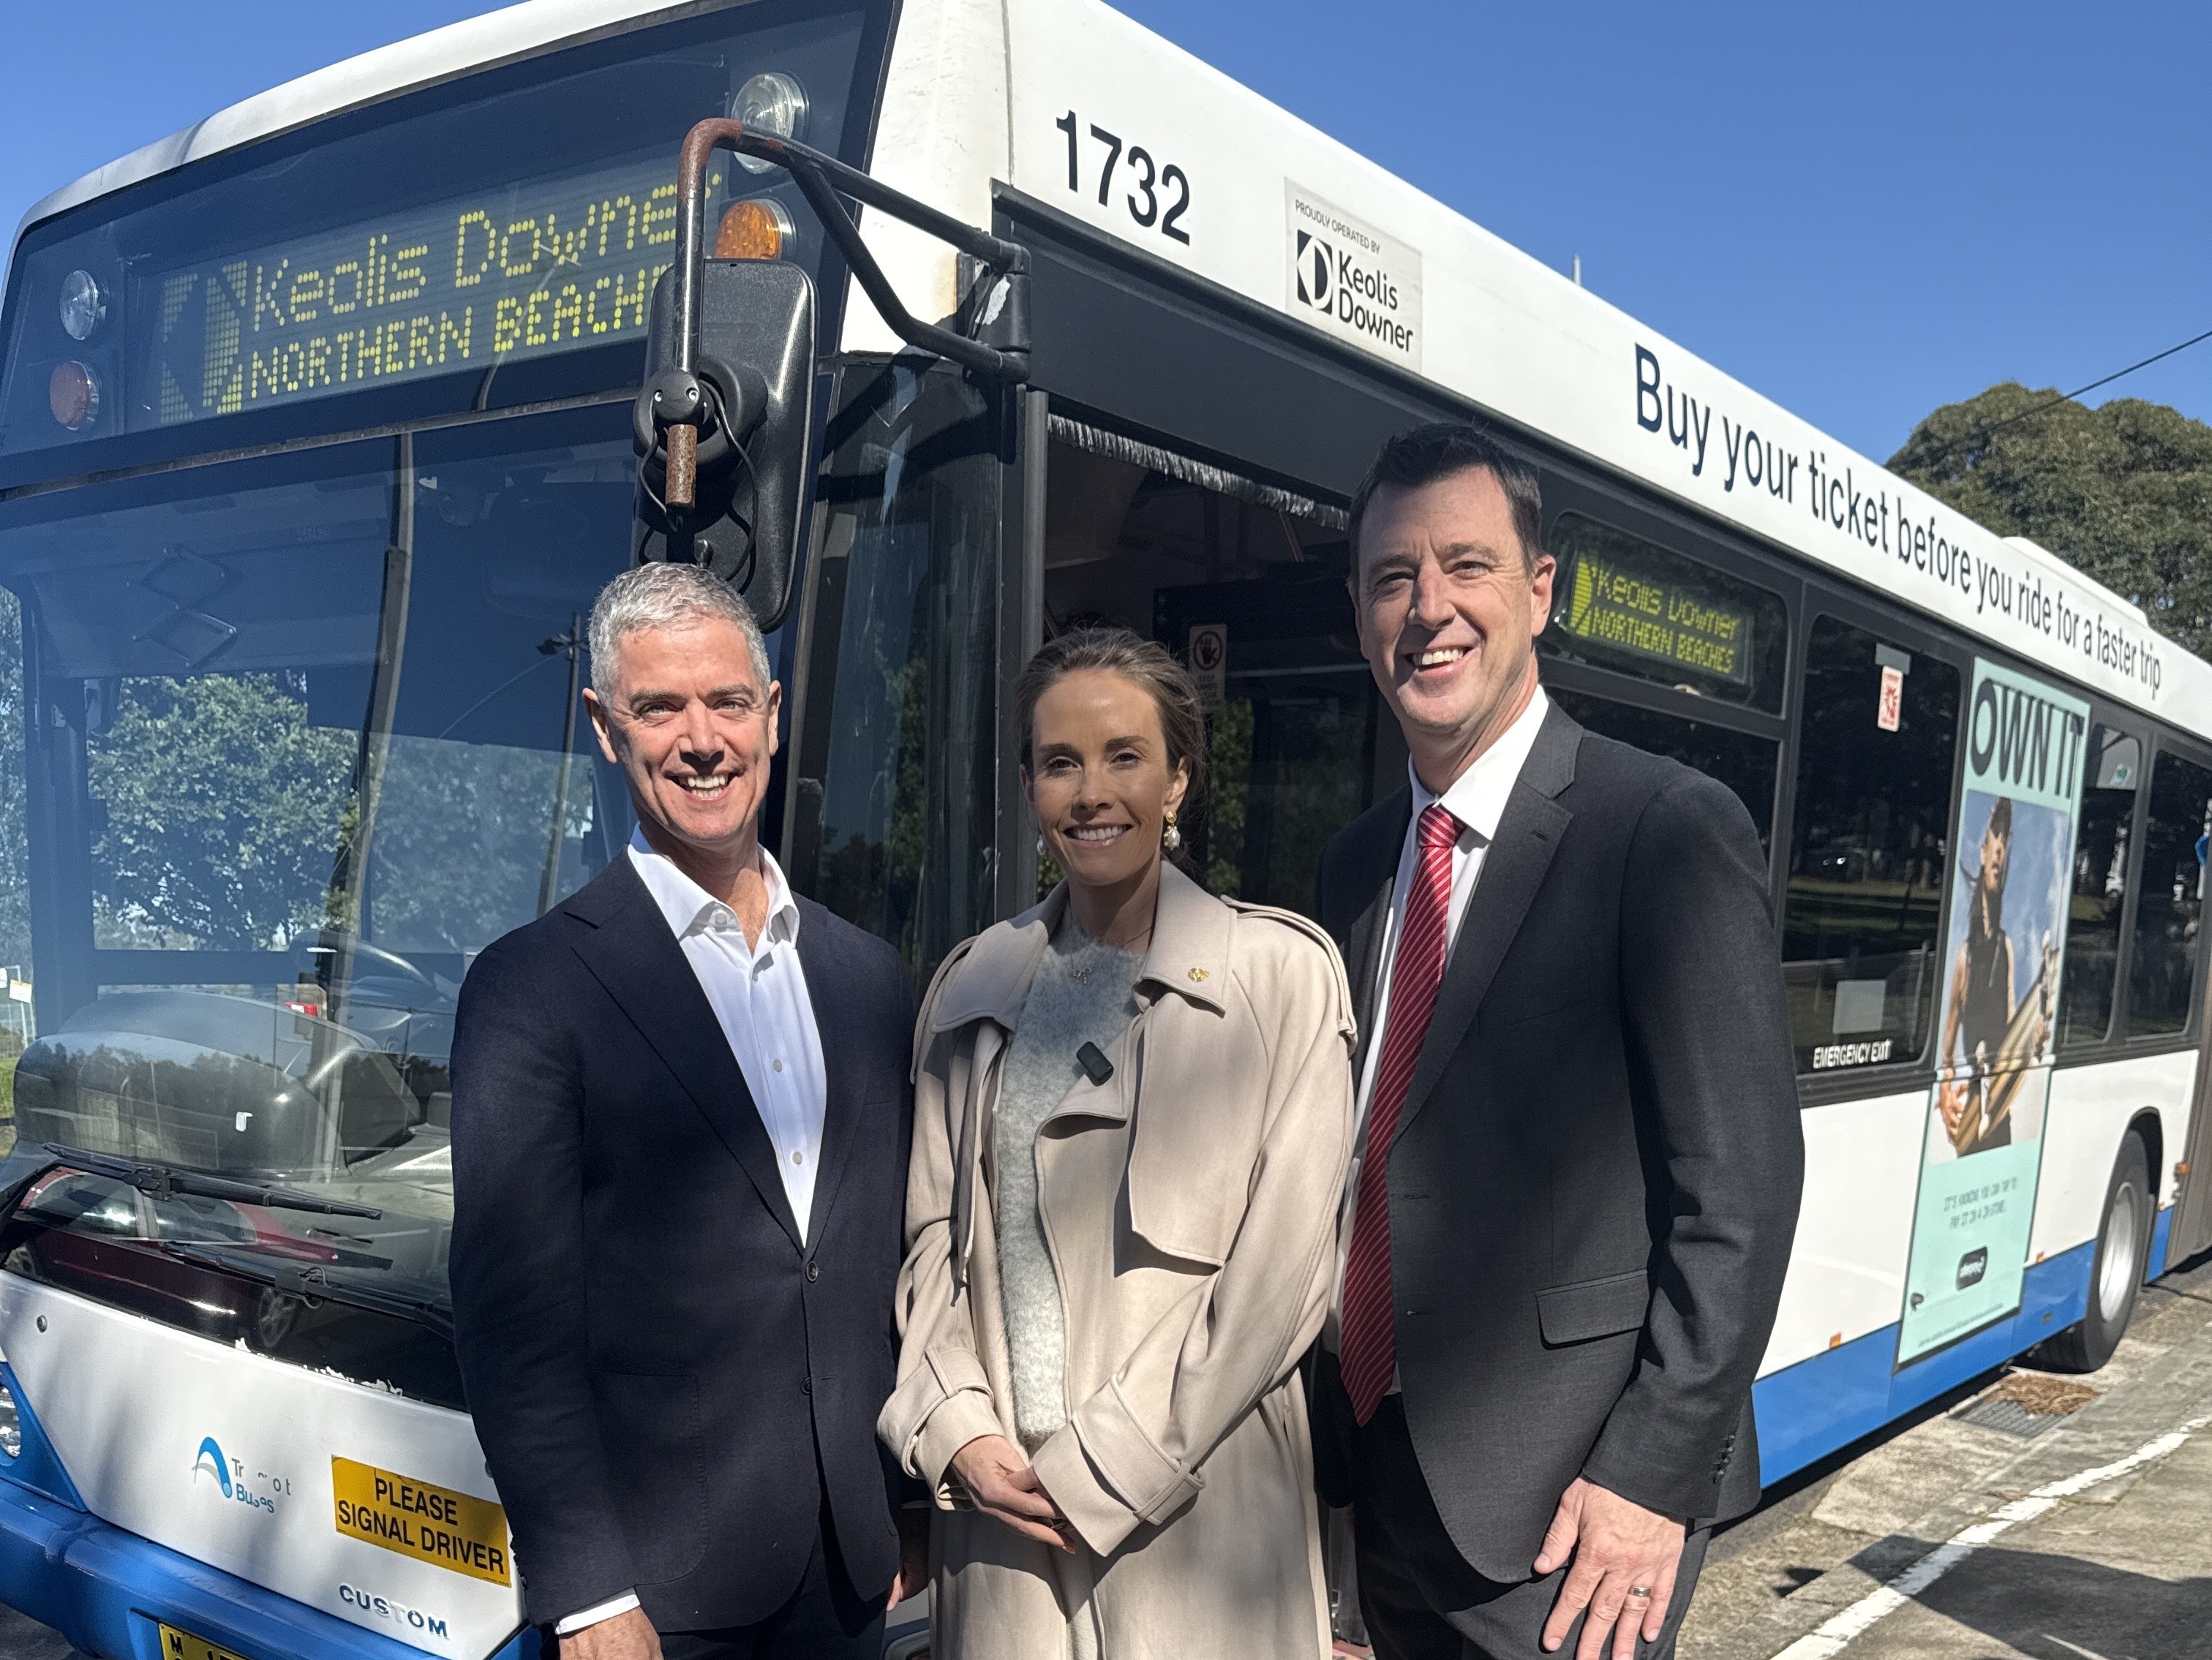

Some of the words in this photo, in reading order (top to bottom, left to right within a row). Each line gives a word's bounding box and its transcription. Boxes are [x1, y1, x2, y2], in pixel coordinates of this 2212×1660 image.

[1056, 109, 1190, 247] 1732
[255, 234, 429, 332] Keolis
[455, 173, 721, 287] Downe
[1295, 199, 1330, 228] PROUDLY
[1331, 219, 1370, 249] OPERATED
[1370, 239, 1380, 254] BY
[1339, 249, 1399, 311] Keolis
[251, 306, 473, 399] NORTHERN
[494, 263, 673, 352] BEACH
[1339, 287, 1414, 352] Downer
[1635, 342, 1710, 478] Buy
[1722, 415, 1799, 505] your
[1808, 450, 1889, 554] ticket
[1897, 496, 1971, 595] before
[1976, 557, 2012, 615] you
[2017, 570, 2052, 636] ride
[2056, 589, 2080, 649] for
[2083, 618, 2093, 657] a
[2096, 613, 2137, 678] faster
[2140, 638, 2161, 701] trip
[1596, 569, 1663, 616] Keolis
[1591, 605, 1674, 656] NORTHERN
[1676, 633, 1735, 674] BEACHES
[1970, 676, 2055, 793] OWN
[2054, 709, 2085, 800] IT
[1813, 1041, 1871, 1069] EMERGENCY
[1870, 1038, 1894, 1063] EXIT
[375, 1476, 458, 1527] PLEASE
[338, 1499, 415, 1547] SIGNAL
[421, 1525, 505, 1575] DRIVER
